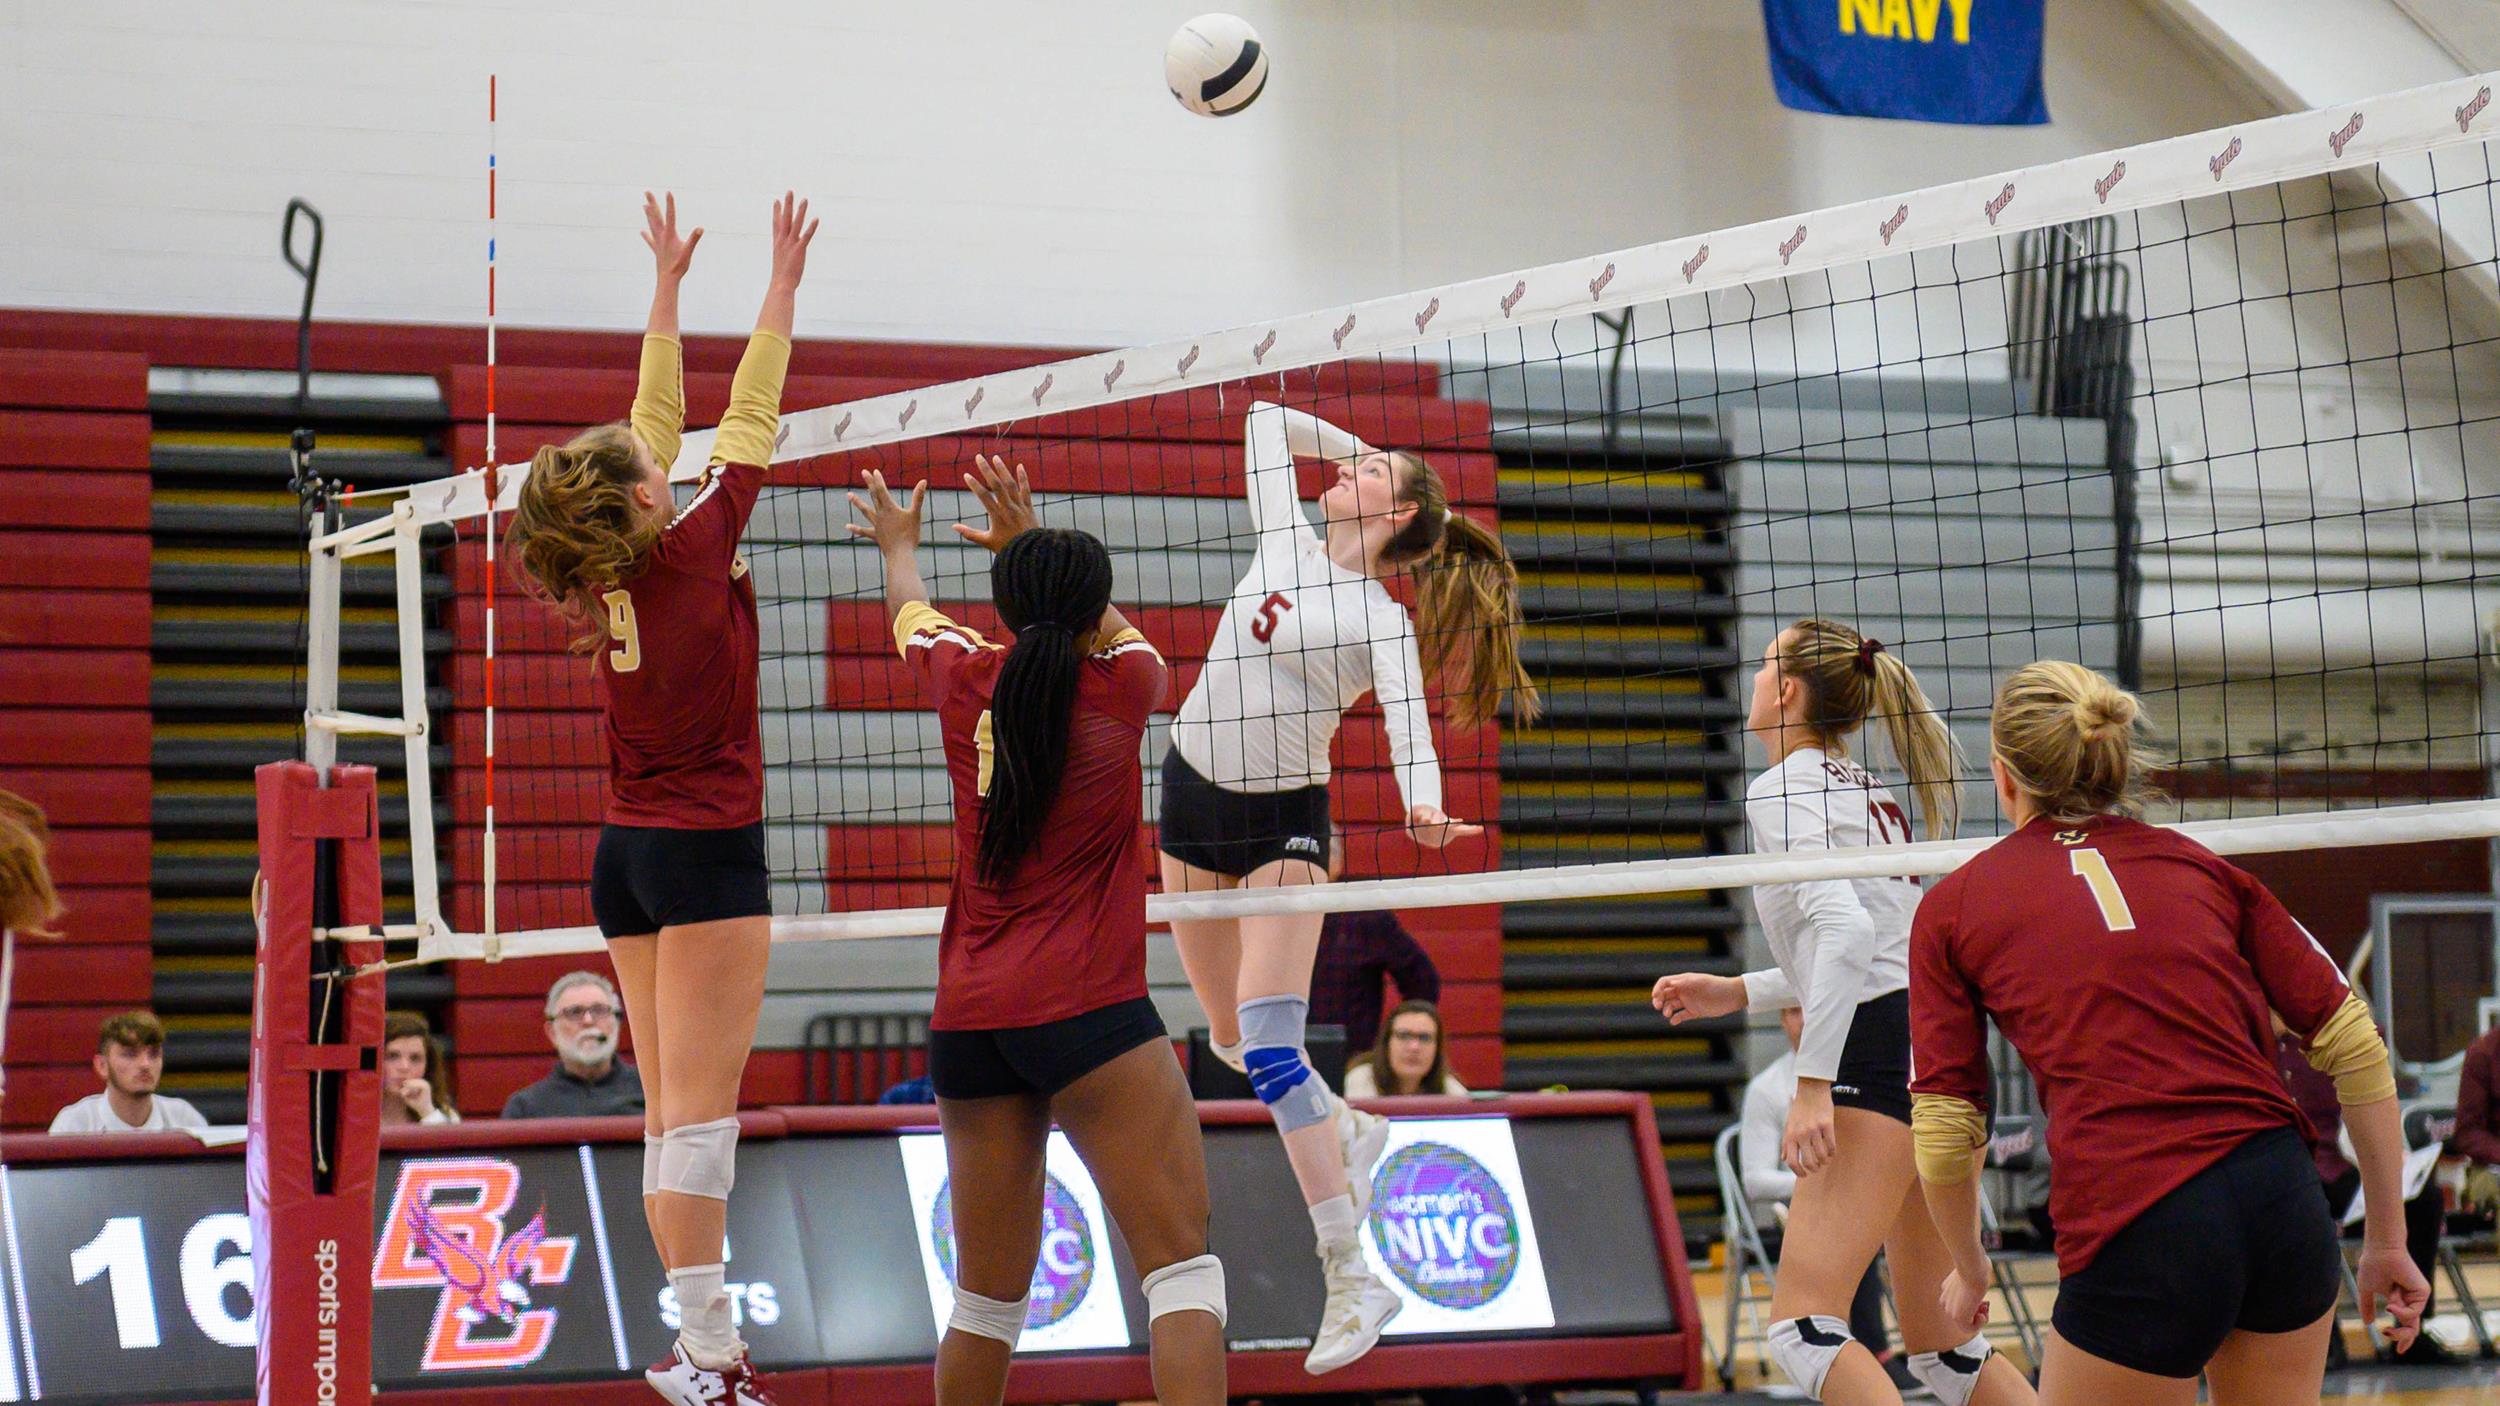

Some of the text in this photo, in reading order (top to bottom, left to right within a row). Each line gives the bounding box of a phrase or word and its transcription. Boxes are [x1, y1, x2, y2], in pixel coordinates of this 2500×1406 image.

[1838, 0, 1973, 44] NAVY
[602, 589, 641, 673] 9
[1252, 592, 1293, 644] 5
[2069, 847, 2136, 932] 1
[1383, 1213, 1513, 1262] NIVC
[70, 1213, 259, 1348] 16
[314, 1239, 340, 1325] sports
[657, 1281, 781, 1330] STS
